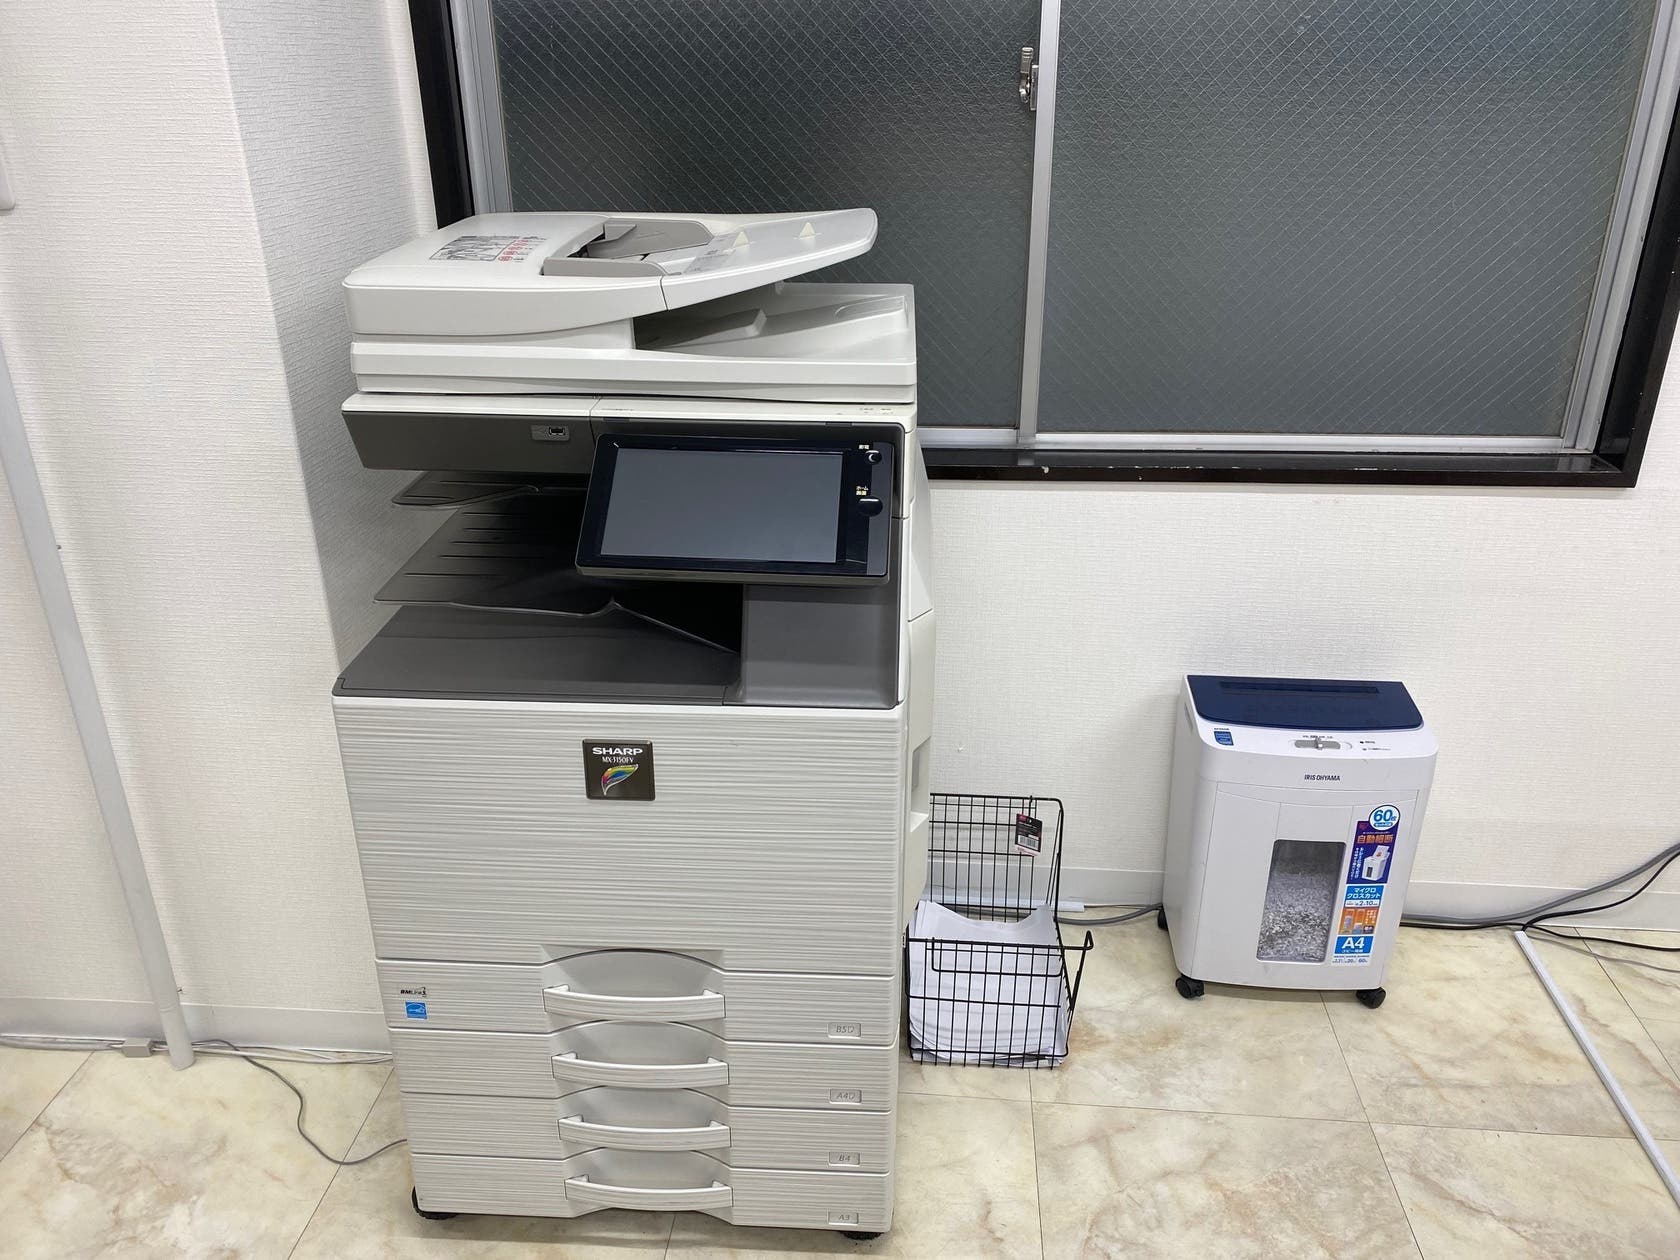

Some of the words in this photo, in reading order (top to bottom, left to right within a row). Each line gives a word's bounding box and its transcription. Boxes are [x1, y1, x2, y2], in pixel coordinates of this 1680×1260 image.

[592, 747, 643, 755] SHARP
[1357, 834, 1394, 843] 自動細断
[1341, 937, 1365, 949] A4
